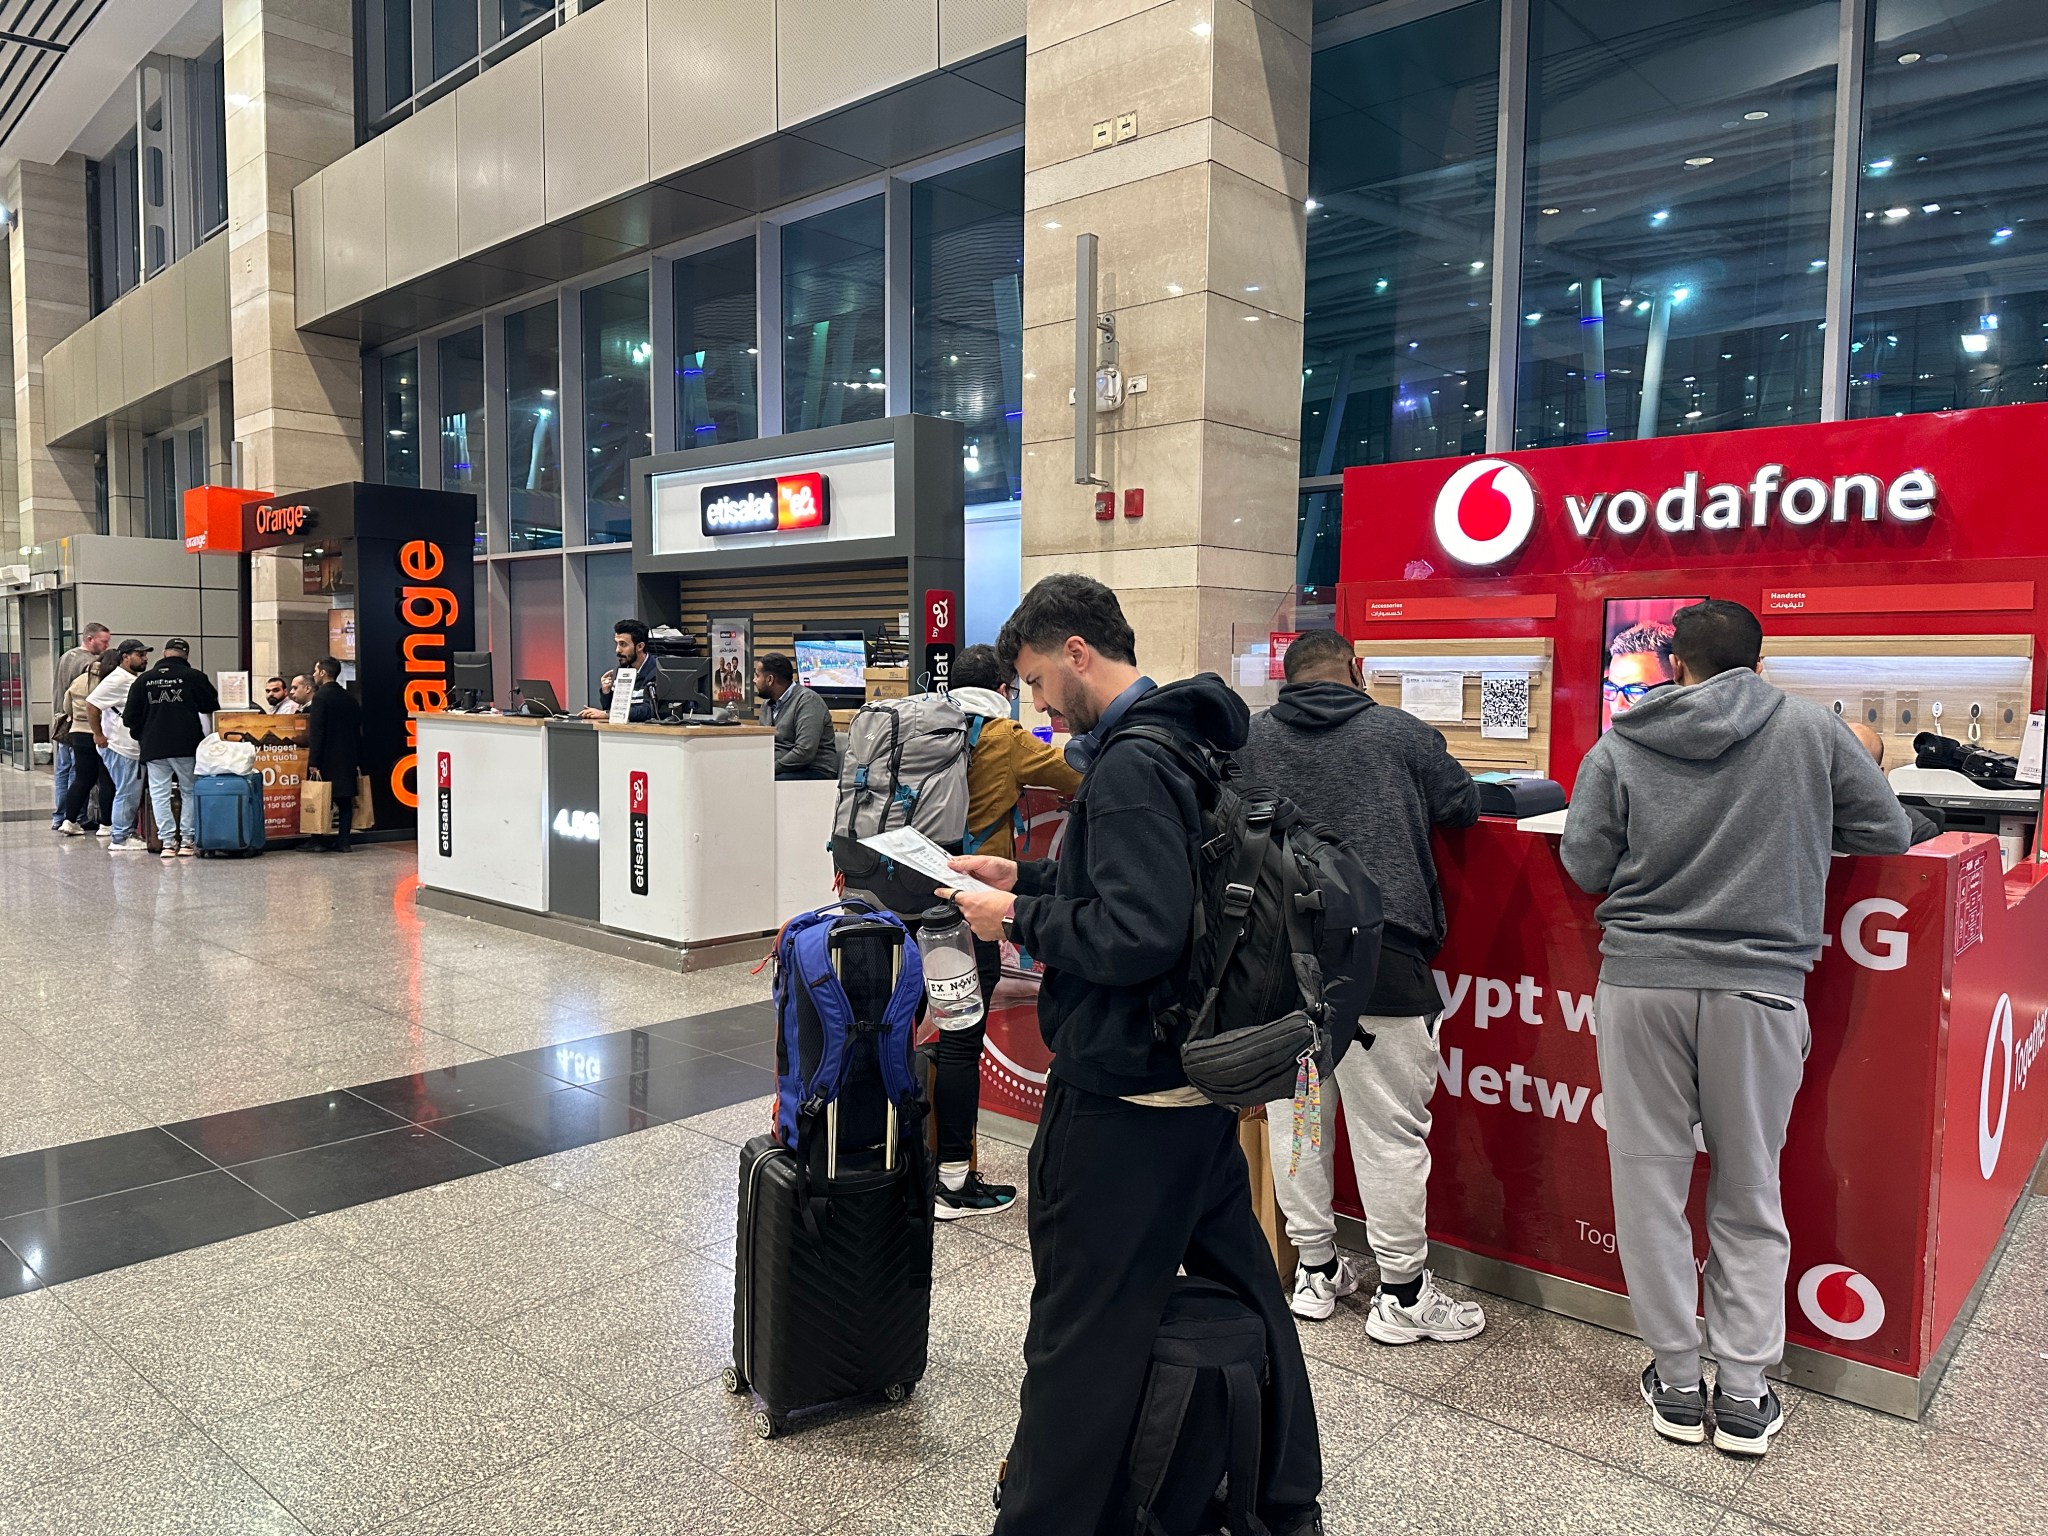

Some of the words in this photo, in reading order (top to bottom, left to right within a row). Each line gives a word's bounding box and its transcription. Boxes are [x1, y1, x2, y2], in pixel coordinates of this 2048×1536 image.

[706, 492, 775, 526] etisalat
[1563, 463, 1937, 537] vodafone
[256, 505, 304, 535] Orange
[185, 533, 207, 549] orange
[931, 626, 940, 638] by
[147, 689, 183, 704] LAX
[263, 744, 297, 752] biggest
[279, 774, 300, 786] GB
[440, 792, 450, 851] etisalat
[633, 820, 644, 888] etisalat
[1812, 897, 1909, 971] G
[930, 983, 945, 992] EX
[1575, 1219, 1617, 1254] Tog
